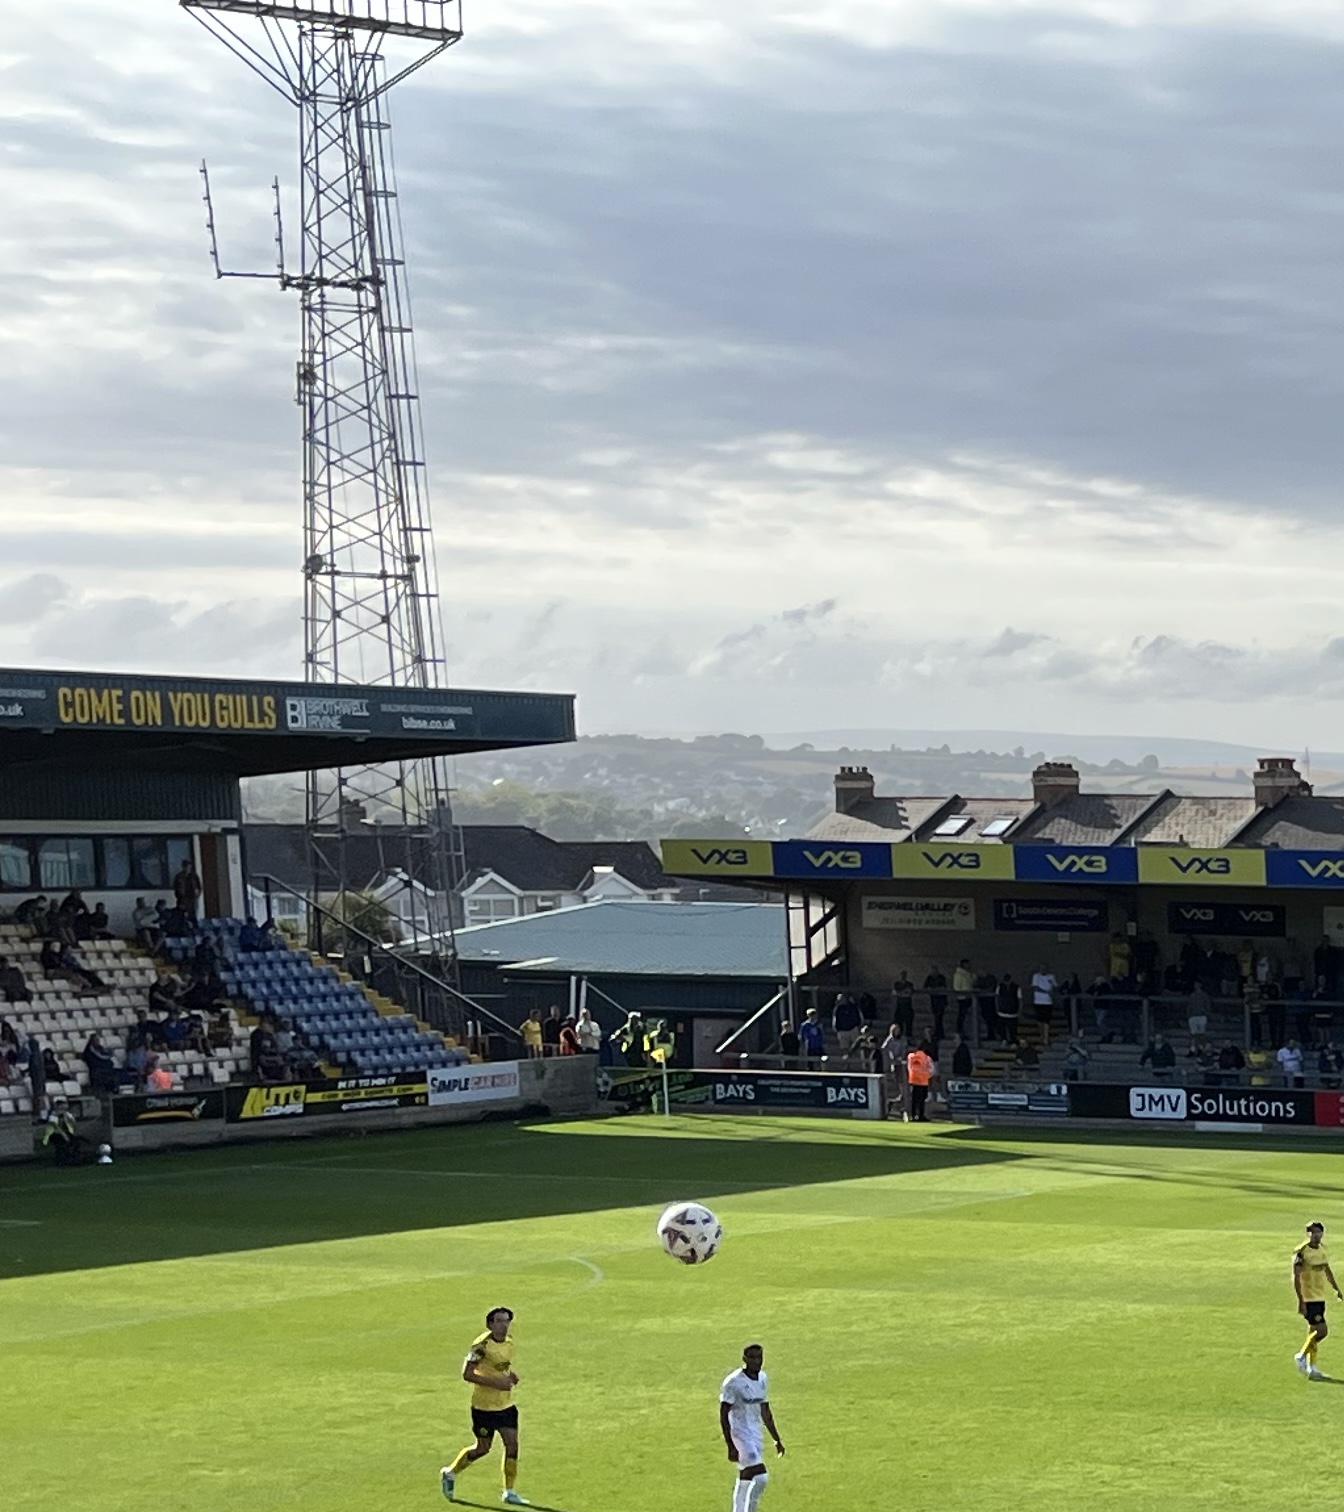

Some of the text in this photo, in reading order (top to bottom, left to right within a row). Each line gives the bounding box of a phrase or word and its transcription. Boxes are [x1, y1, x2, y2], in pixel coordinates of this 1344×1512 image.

[57, 686, 277, 730] COME ON YOU GULLS
[308, 715, 343, 730] IRVINE
[691, 847, 749, 866] VX3
[803, 848, 863, 869] VX3
[921, 849, 982, 870] VX3
[1047, 853, 1108, 874] VX3
[1169, 855, 1232, 876] VX3
[431, 1077, 470, 1093] SIMPLE
[714, 1083, 756, 1101] BAYS
[826, 1086, 867, 1104] BAYS
[1134, 1091, 1297, 1119] JMV Solutions
